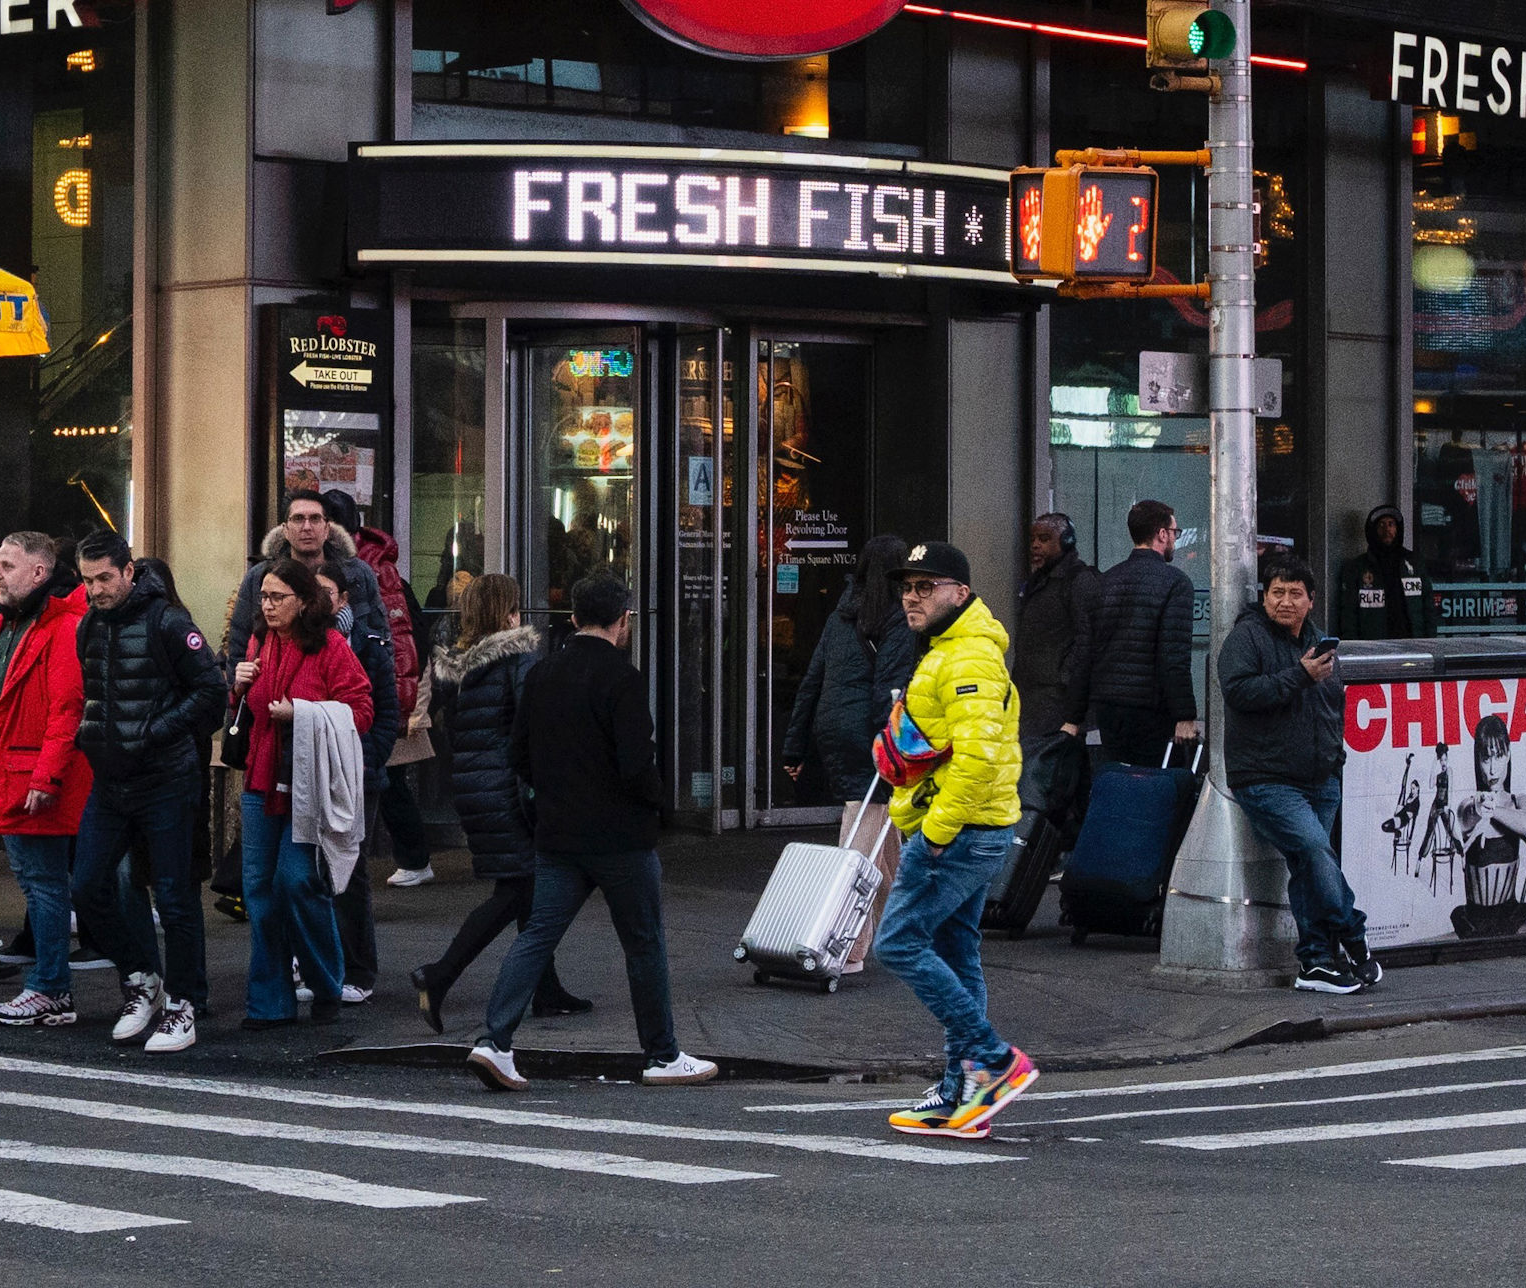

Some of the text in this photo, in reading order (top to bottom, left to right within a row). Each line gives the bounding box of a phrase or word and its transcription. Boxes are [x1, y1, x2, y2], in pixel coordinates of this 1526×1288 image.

[514, 170, 946, 256] FRESH FISH
[1128, 196, 1149, 261] 2
[290, 335, 377, 357] RED LOBSTER
[314, 369, 358, 381] TAKE OUT
[693, 463, 711, 492] A
[795, 510, 839, 523] Please Use
[785, 523, 848, 537] Revolving Door
[785, 554, 806, 565] Times
[807, 554, 832, 567] Square
